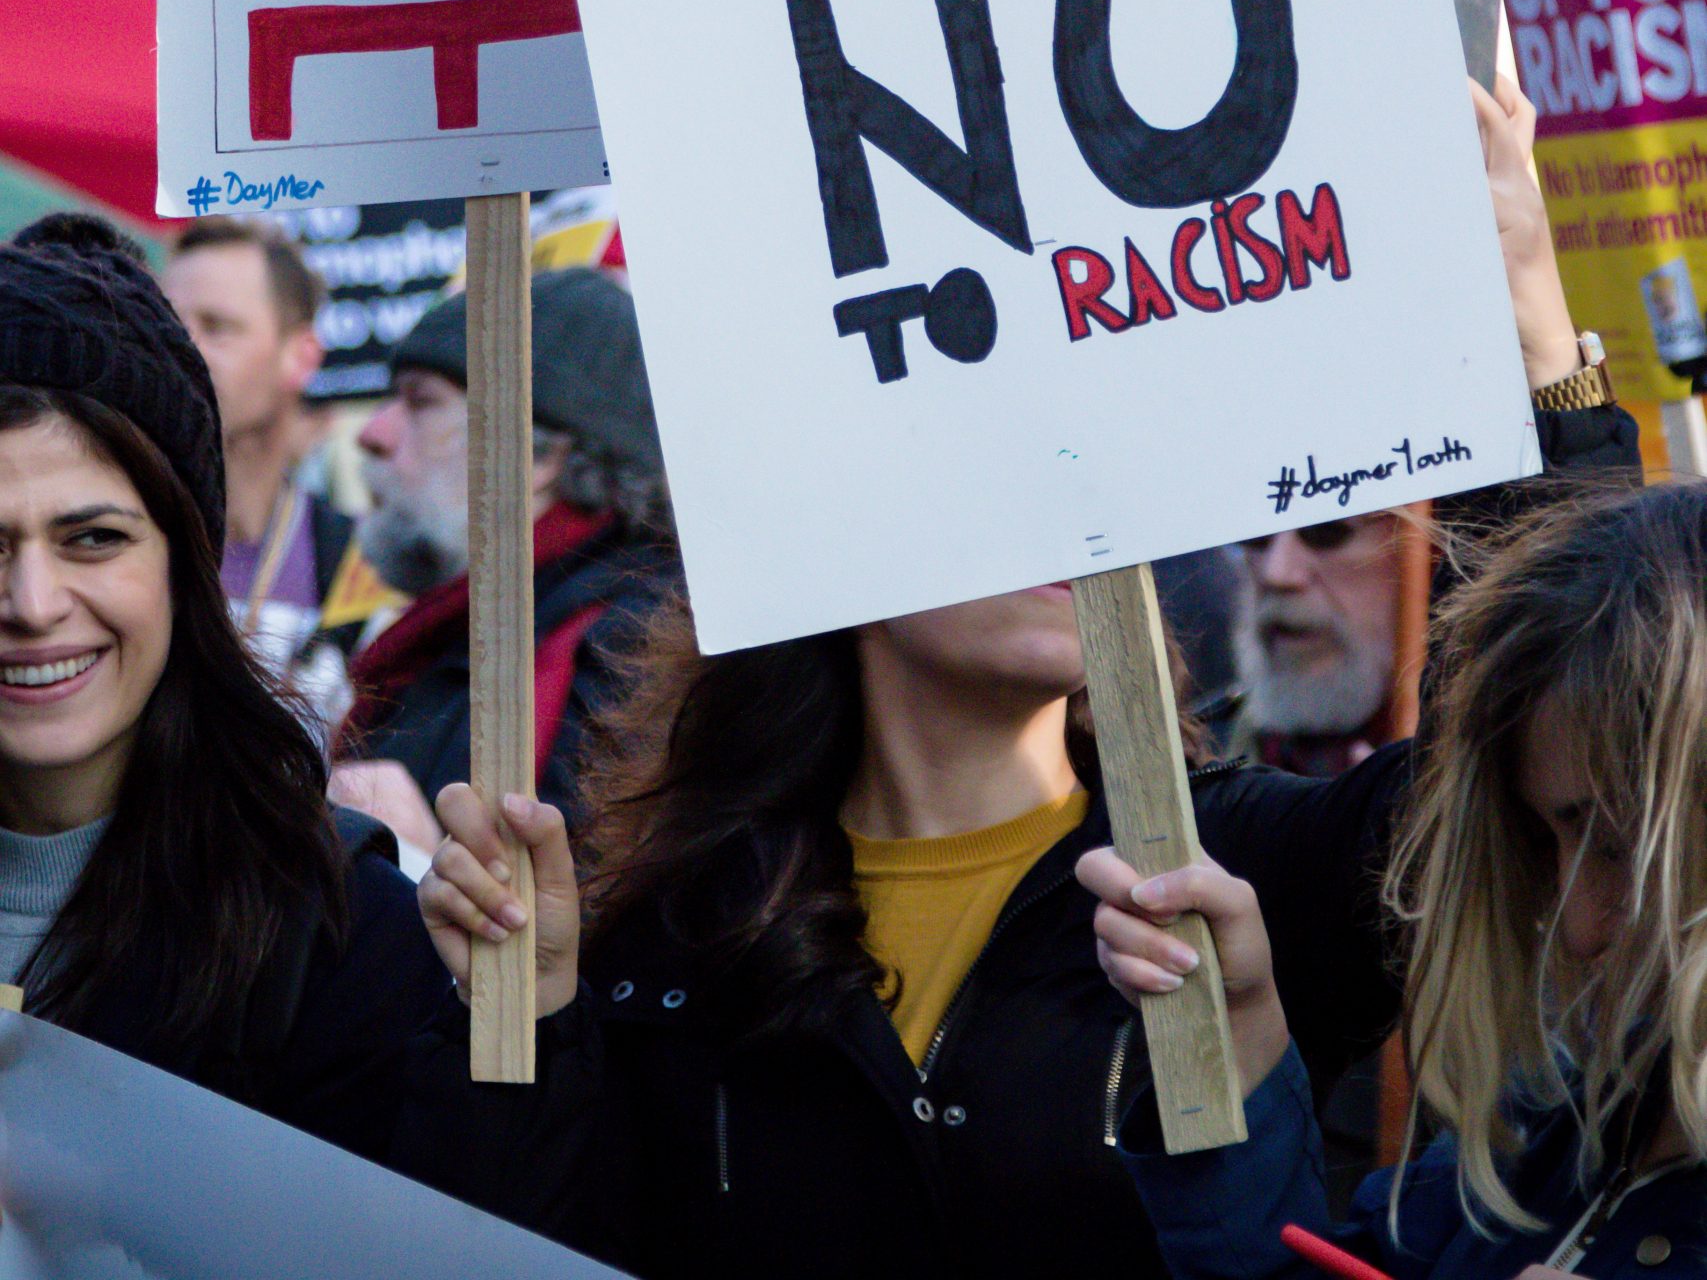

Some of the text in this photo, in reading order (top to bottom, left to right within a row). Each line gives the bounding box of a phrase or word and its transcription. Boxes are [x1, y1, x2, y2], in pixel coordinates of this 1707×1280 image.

[187, 171, 325, 216] #DayMer
[1542, 158, 1573, 198] No
[1556, 210, 1592, 252] and
[833, 267, 998, 384] TO
